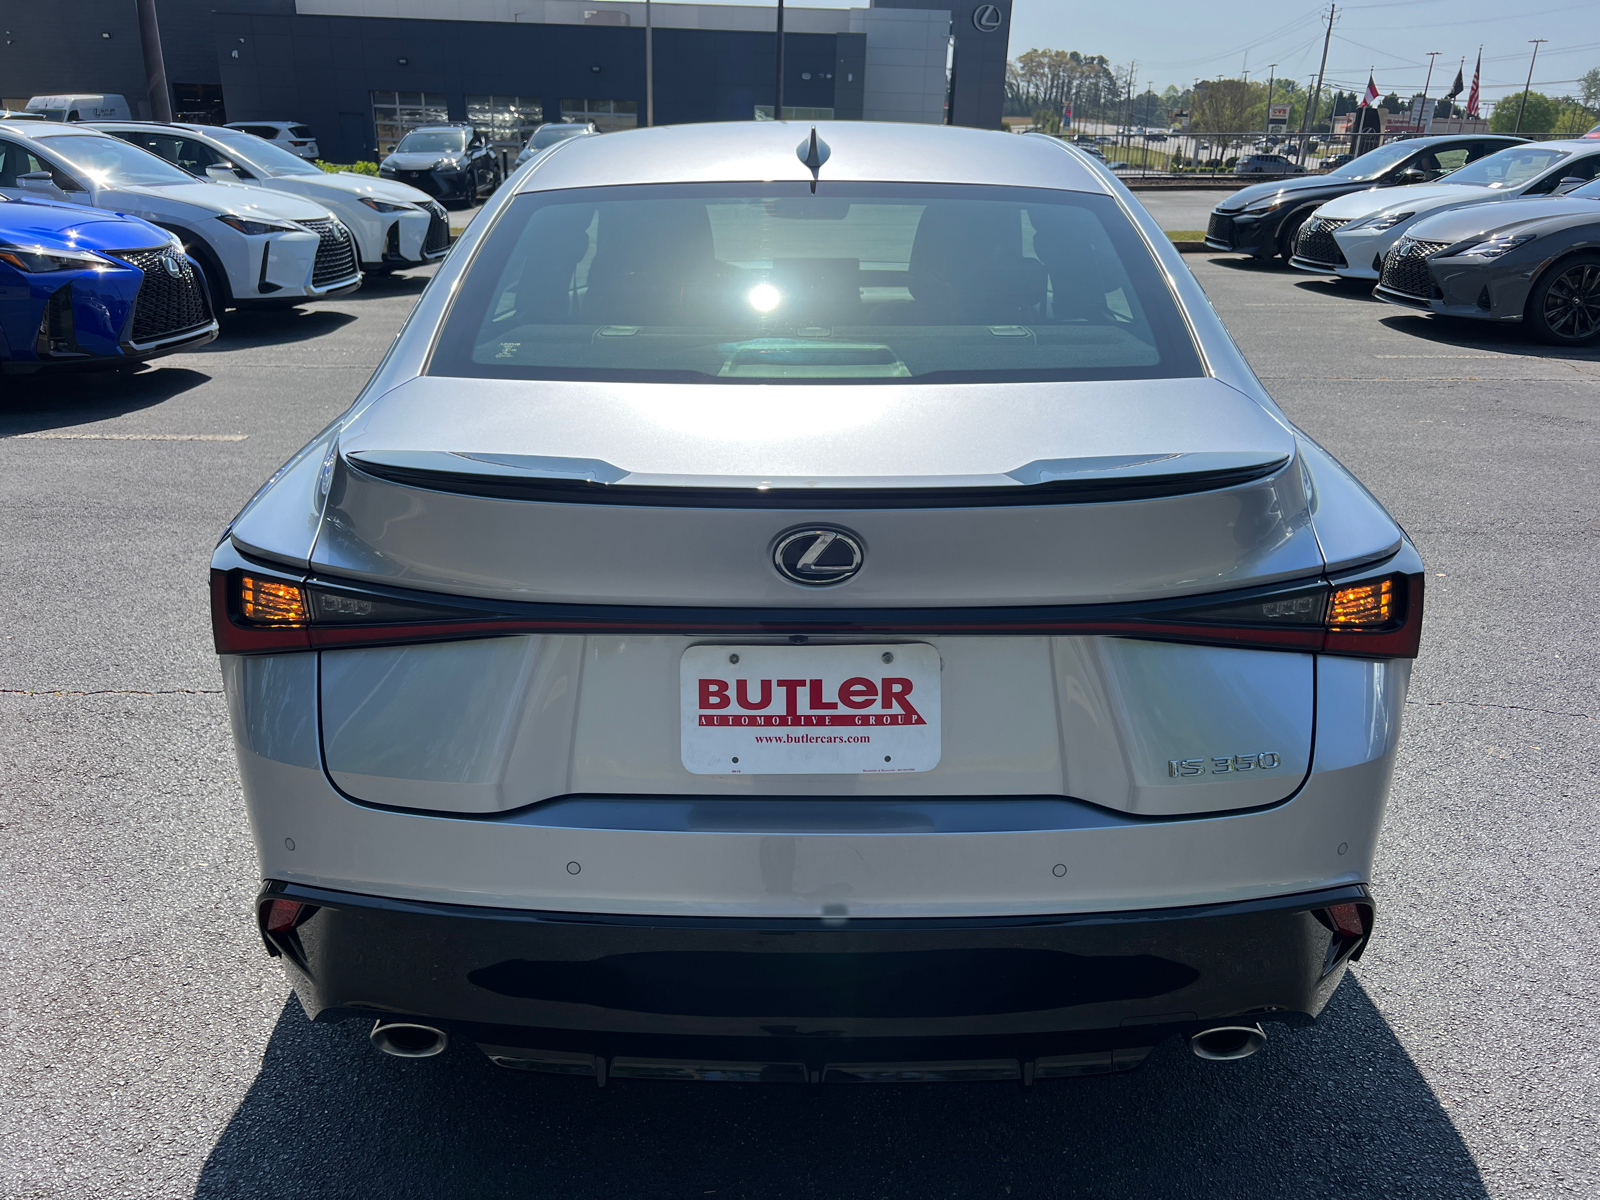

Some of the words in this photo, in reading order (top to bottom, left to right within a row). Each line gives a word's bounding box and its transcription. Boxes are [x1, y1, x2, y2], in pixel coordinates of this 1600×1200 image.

[700, 715, 832, 725] AUTOMOTIVE
[855, 714, 919, 725] GROUP
[755, 733, 871, 745] www.butlercars.com
[1168, 758, 1205, 778] IS
[1211, 751, 1281, 775] 350
